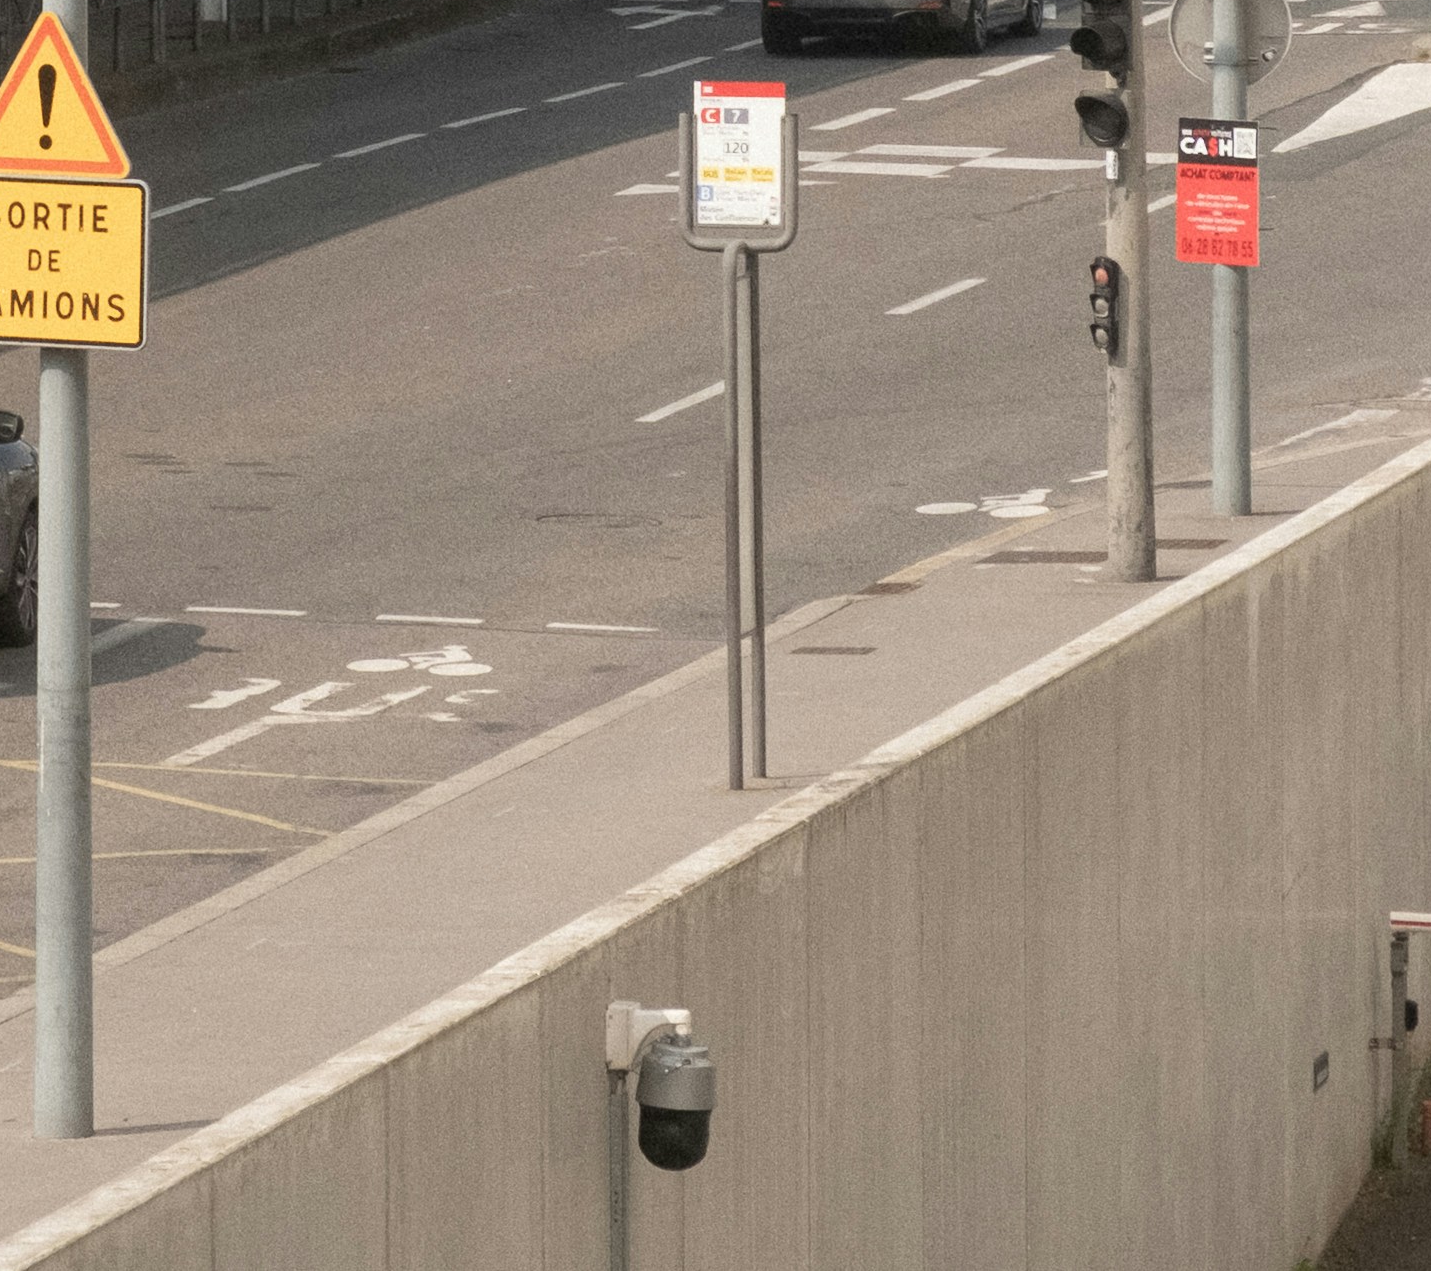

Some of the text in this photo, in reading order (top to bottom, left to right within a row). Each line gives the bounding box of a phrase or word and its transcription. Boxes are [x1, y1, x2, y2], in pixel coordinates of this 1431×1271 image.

[725, 142, 749, 154] 120
[1180, 168, 1256, 182] ACHAT COMPTANT
[27, 248, 61, 273] DE
